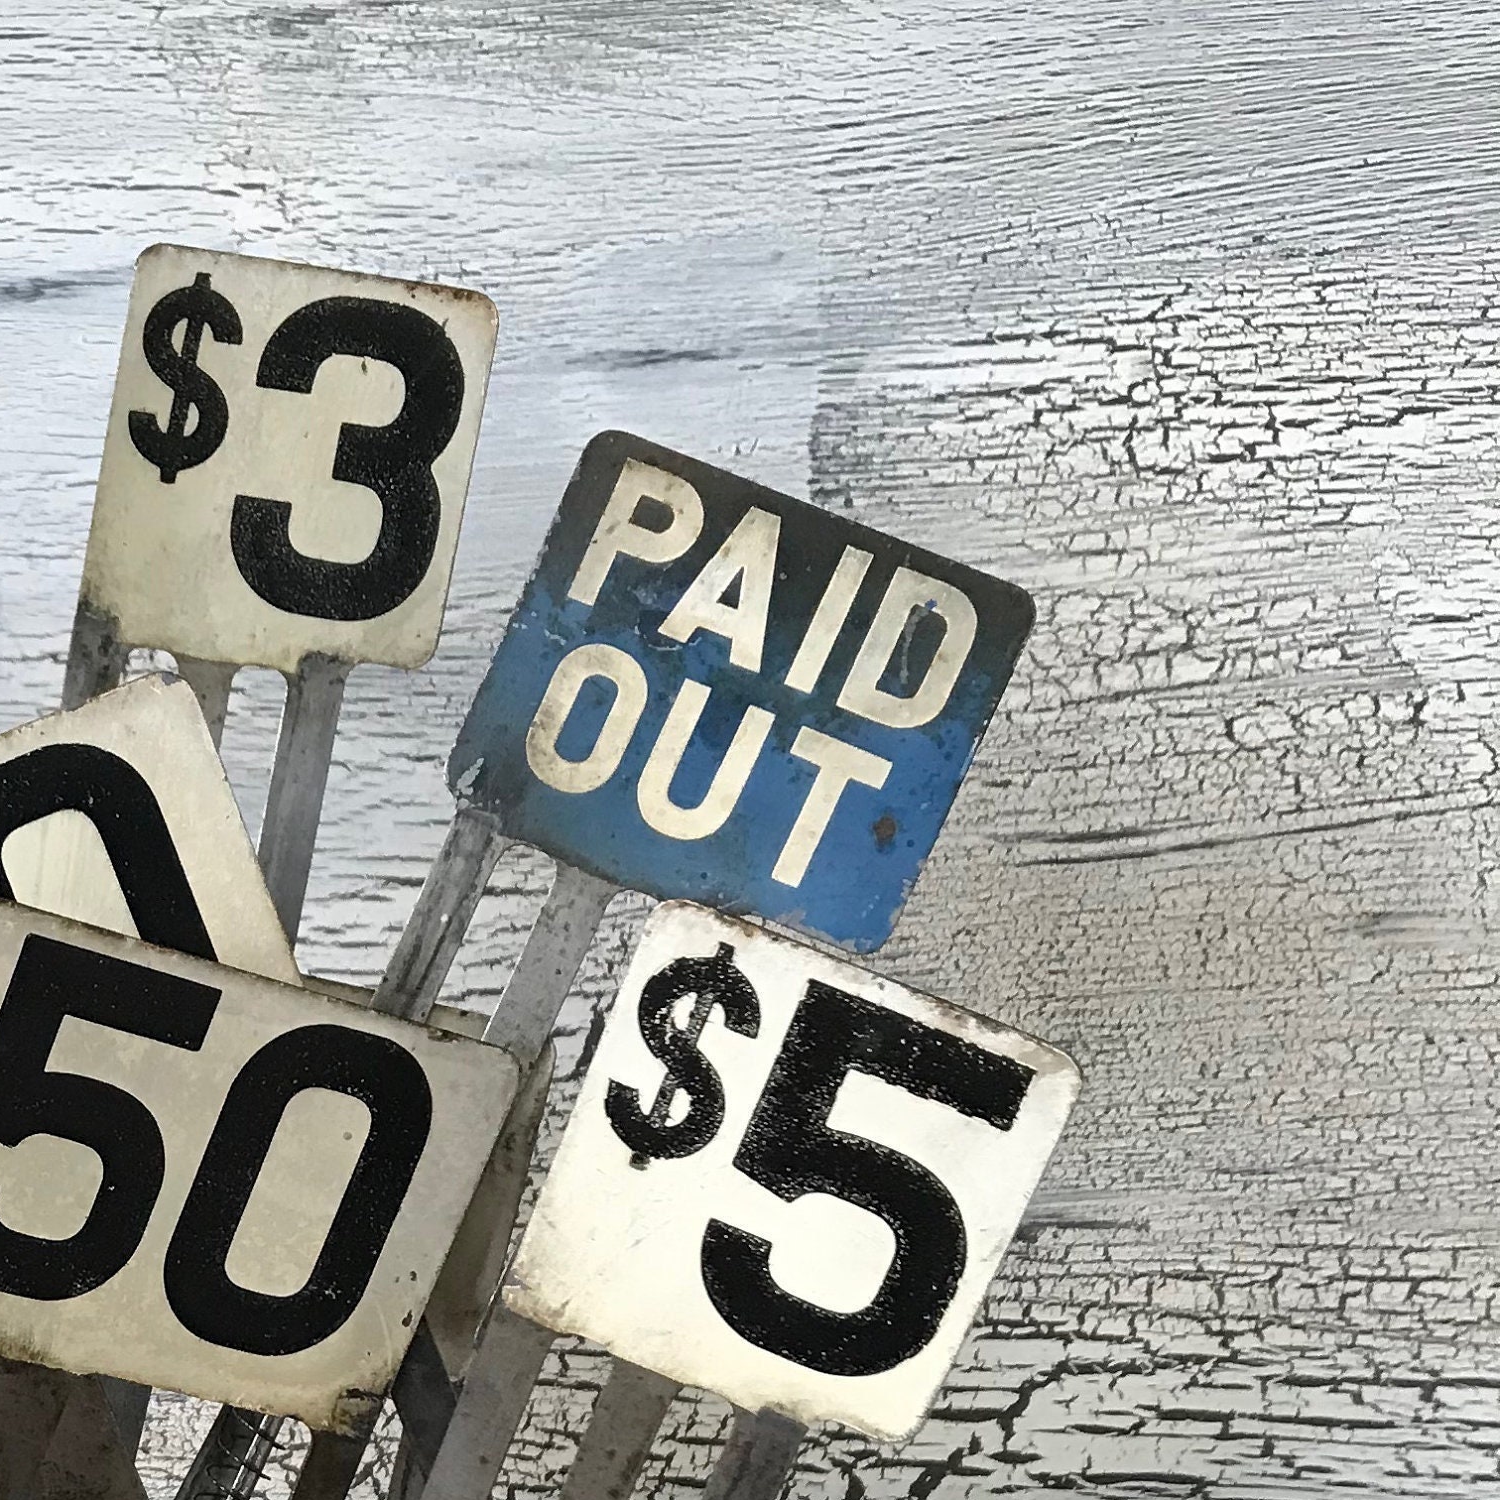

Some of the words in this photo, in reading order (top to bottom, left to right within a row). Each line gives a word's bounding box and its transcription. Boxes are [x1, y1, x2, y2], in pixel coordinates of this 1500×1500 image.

[128, 272, 465, 621] $3
[566, 457, 979, 730] PAID
[525, 643, 893, 889] OUT
[604, 941, 1038, 1377] $5
